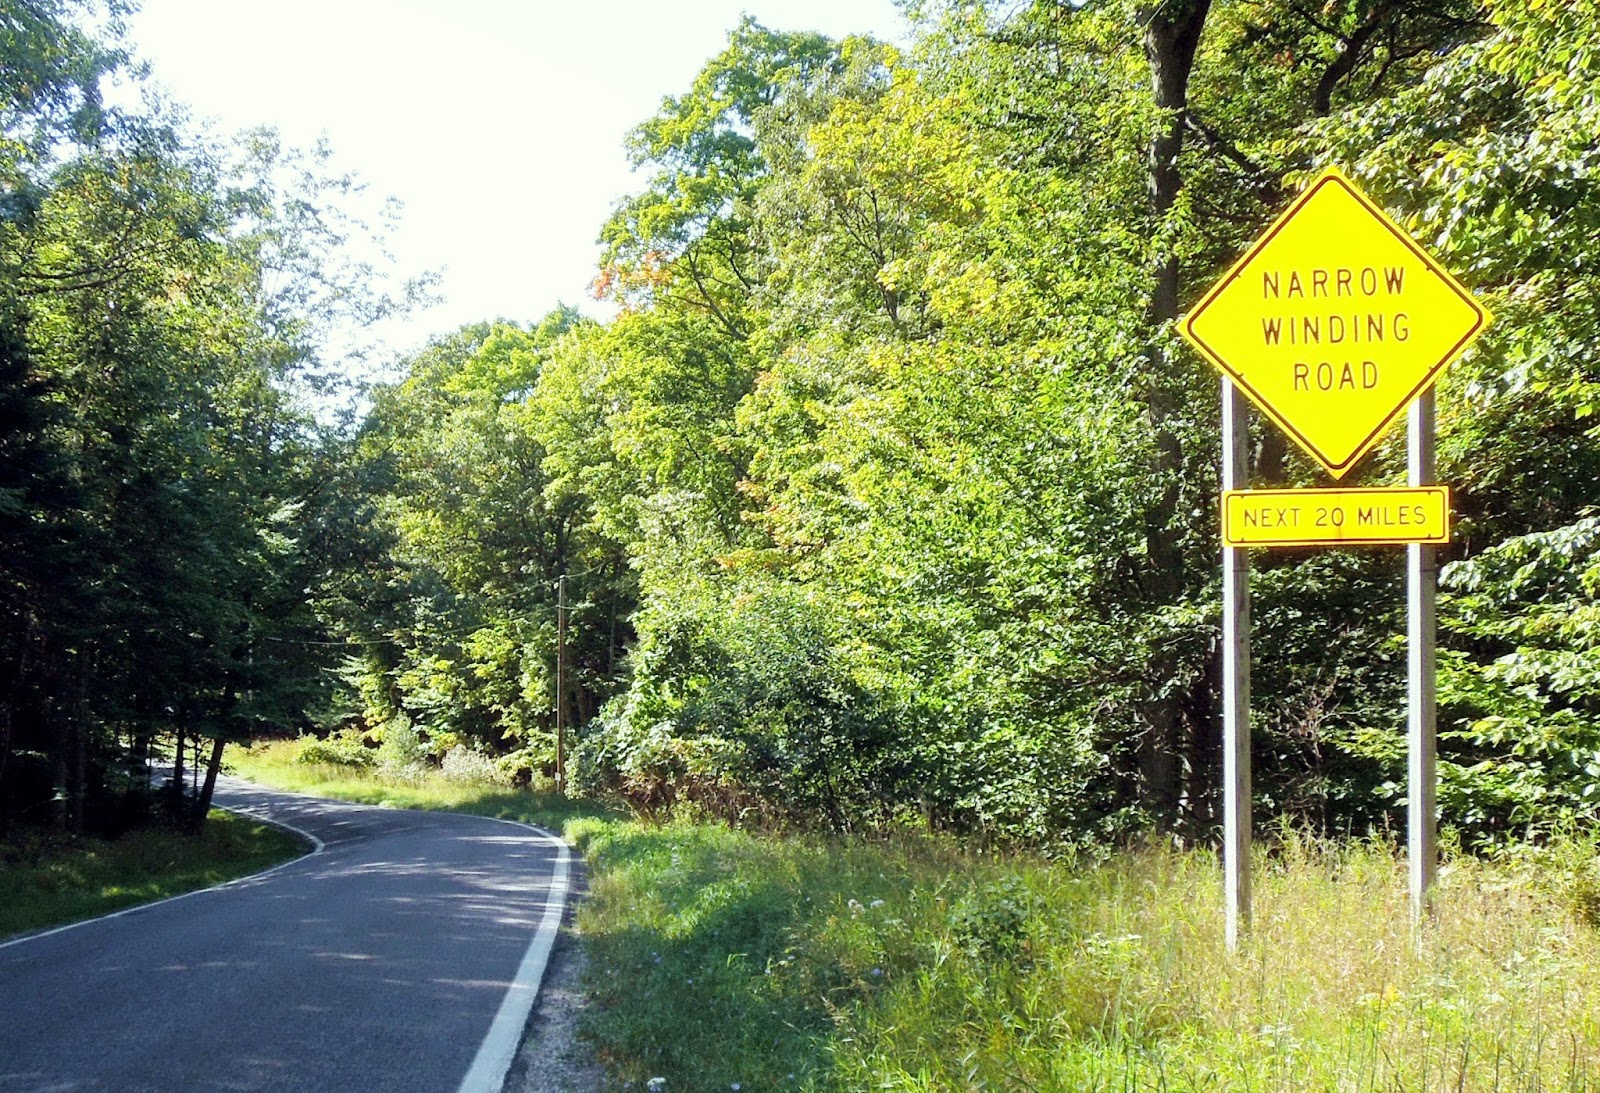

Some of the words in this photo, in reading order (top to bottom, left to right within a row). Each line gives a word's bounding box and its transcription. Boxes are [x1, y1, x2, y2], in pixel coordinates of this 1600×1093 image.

[1263, 266, 1405, 299] NARROW
[1262, 313, 1409, 345] WINDING
[1294, 361, 1378, 391] ROAD
[1244, 507, 1301, 528] NEXT
[1315, 507, 1344, 527] 20
[1358, 505, 1427, 526] MILES
